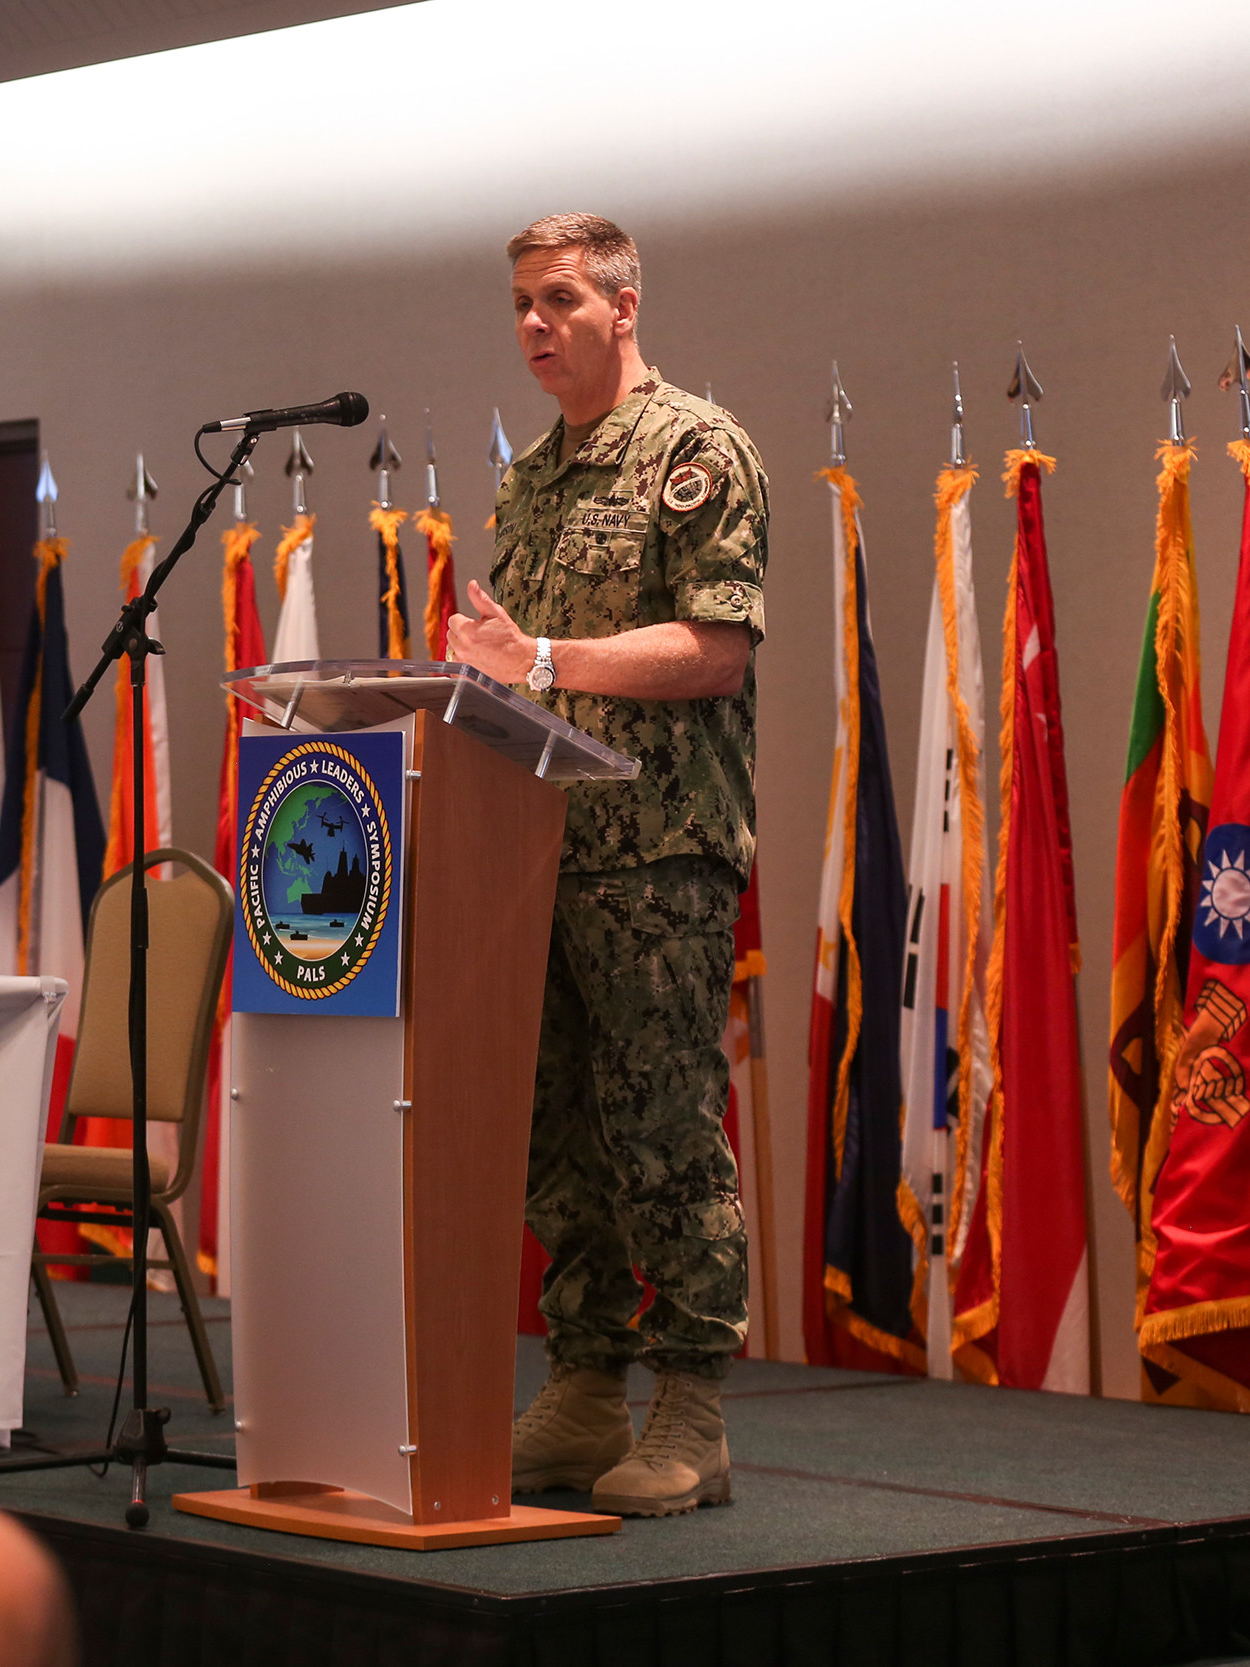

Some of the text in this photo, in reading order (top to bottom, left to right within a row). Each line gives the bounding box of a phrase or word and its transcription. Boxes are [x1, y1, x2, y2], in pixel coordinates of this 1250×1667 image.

[582, 513, 631, 528] U.S. NAVY
[250, 760, 382, 930] PACIFIC AMPHIBIOUS LEADERS SYMPOSIUM
[296, 965, 326, 982] PALS
